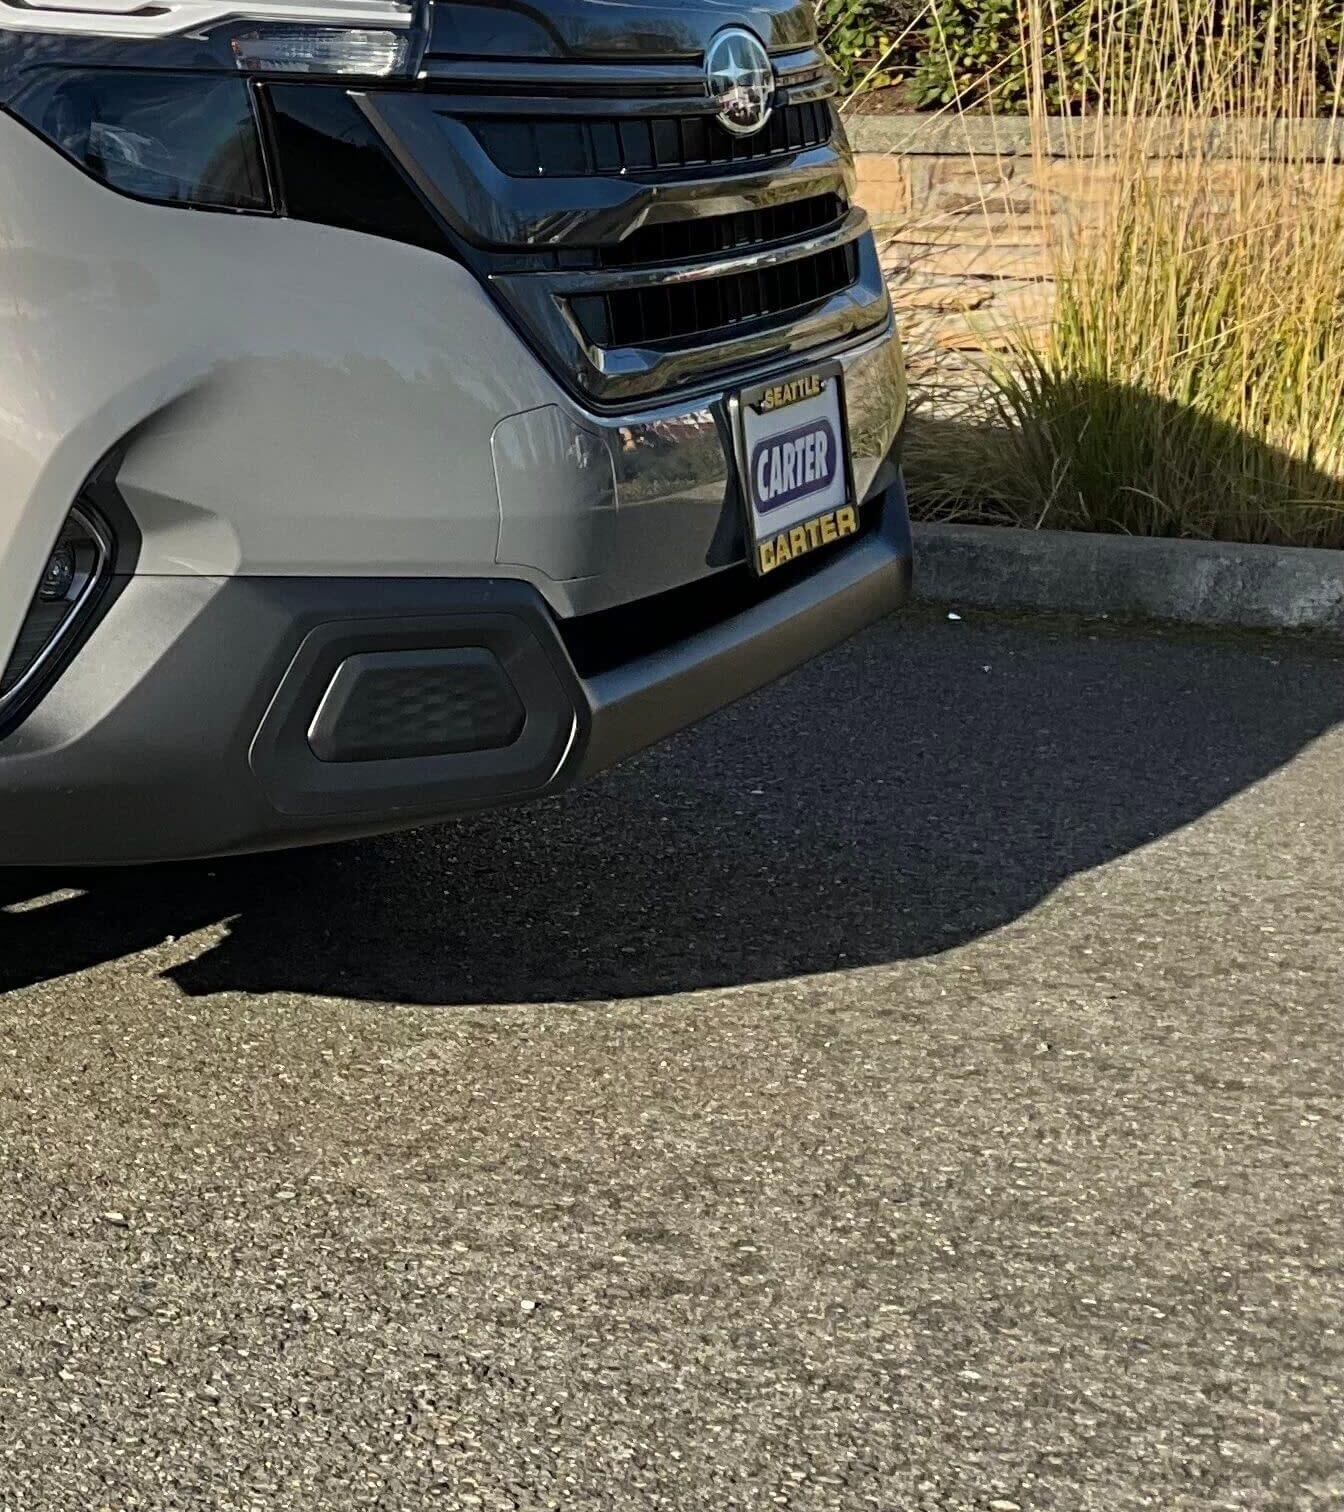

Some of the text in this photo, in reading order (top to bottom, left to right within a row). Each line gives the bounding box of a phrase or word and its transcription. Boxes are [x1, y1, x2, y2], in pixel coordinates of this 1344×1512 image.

[764, 374, 821, 409] SEATTLE
[757, 430, 829, 503] CARTER
[761, 505, 858, 574] CARTER
